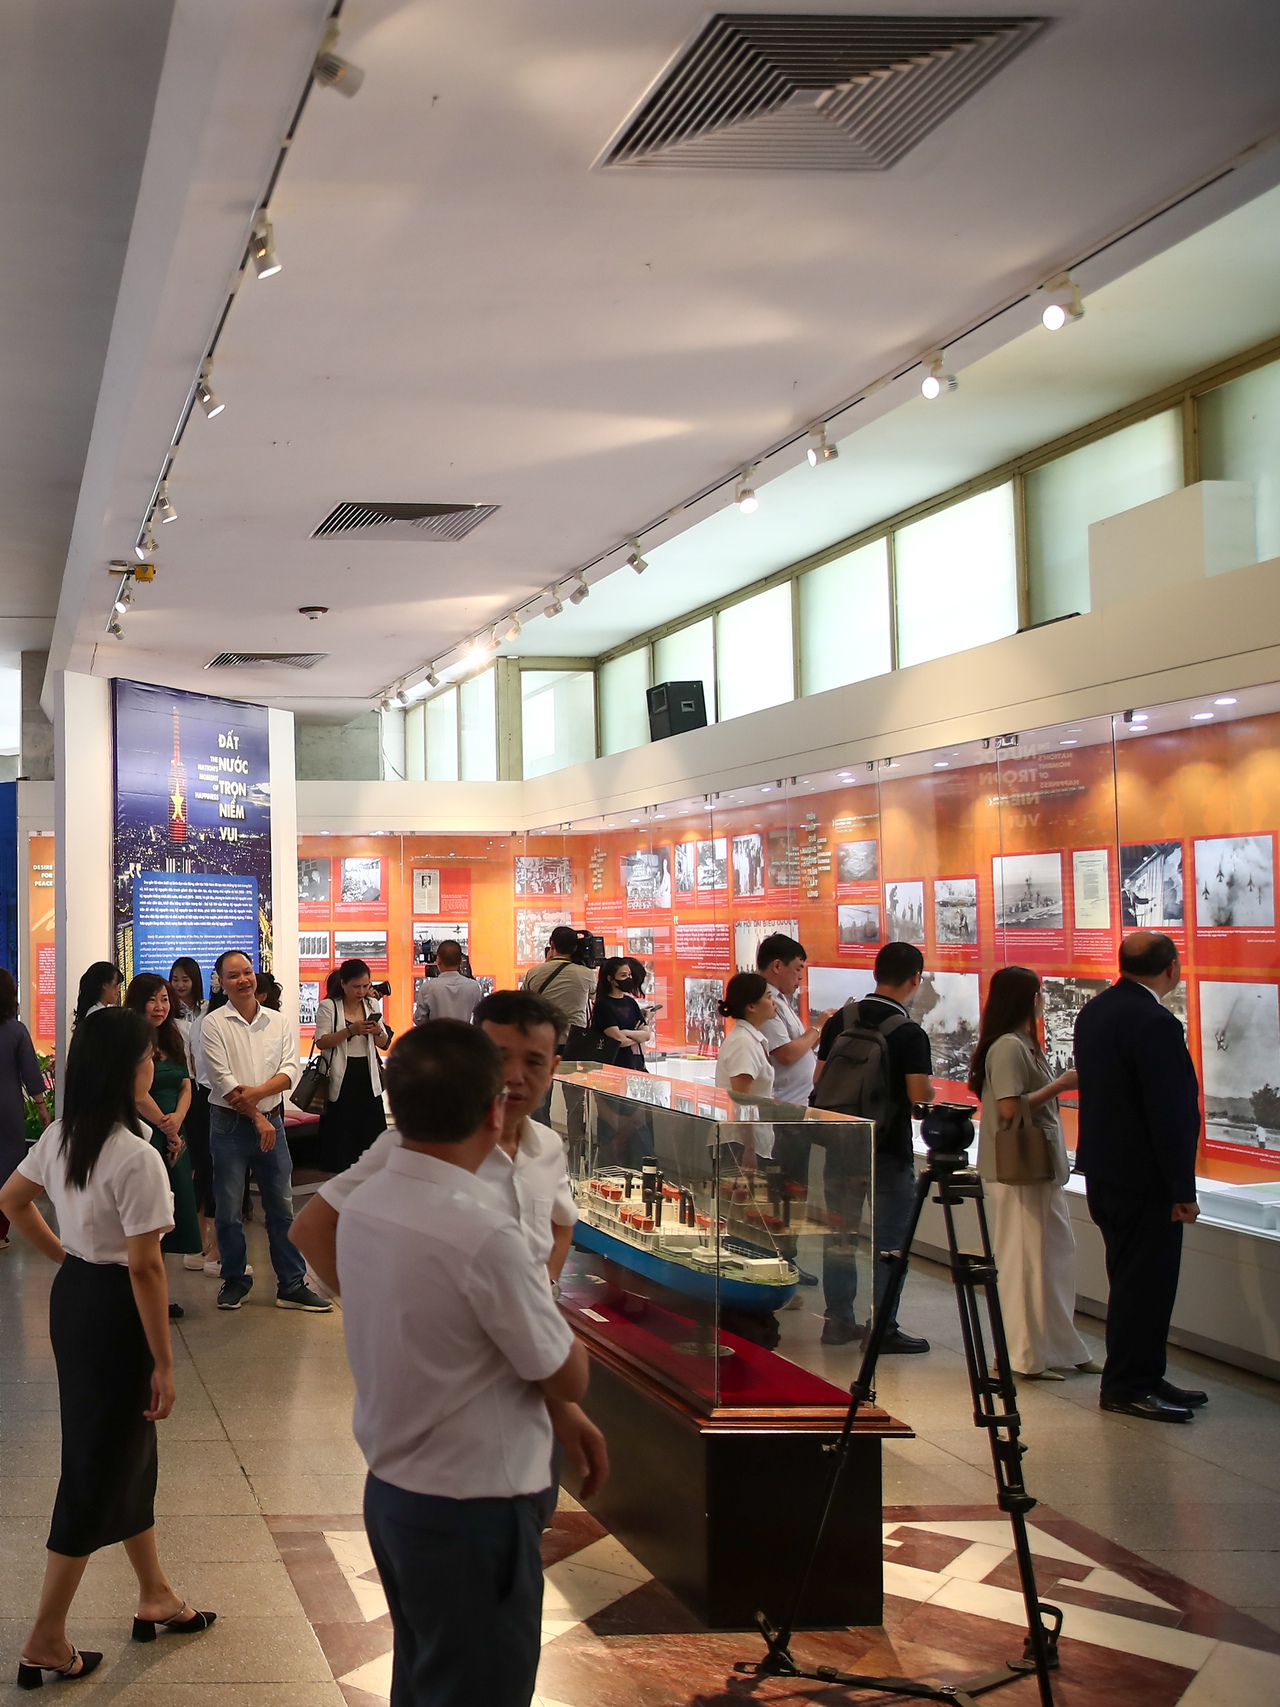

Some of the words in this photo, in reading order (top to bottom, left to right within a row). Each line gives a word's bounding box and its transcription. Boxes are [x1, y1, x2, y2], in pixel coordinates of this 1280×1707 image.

[218, 729, 239, 750] ĐẤT
[210, 755, 218, 763] THE
[218, 755, 249, 775] NƯỚC
[197, 763, 218, 772] NATION'S
[199, 773, 218, 782] MOMENT
[194, 791, 219, 801] HAPPINESS
[218, 780, 247, 798] TRỌN
[219, 798, 245, 820] NIỀM
[219, 826, 238, 842] VUI
